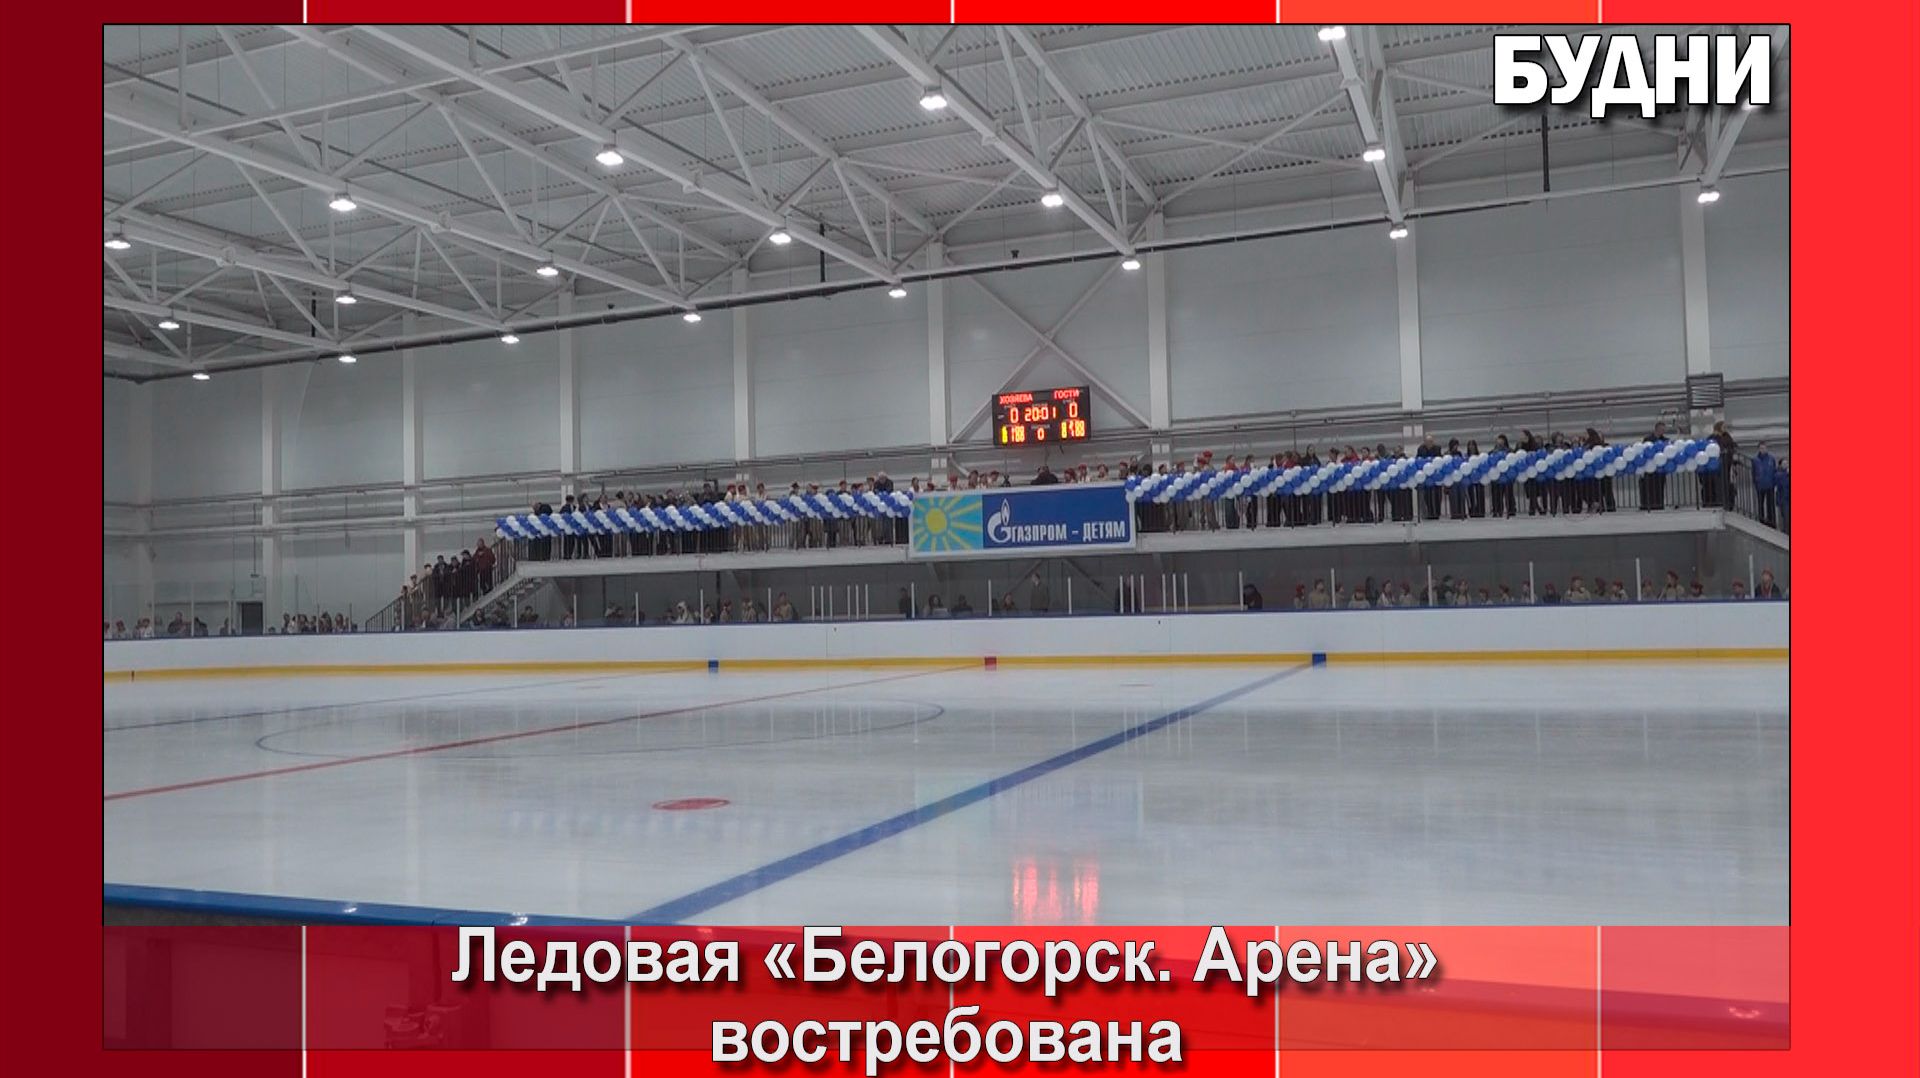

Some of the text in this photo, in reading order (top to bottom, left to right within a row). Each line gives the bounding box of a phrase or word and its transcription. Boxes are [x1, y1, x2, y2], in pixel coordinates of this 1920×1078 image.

[1054, 389, 1080, 400] ГОСТИ
[1010, 406, 1019, 424] 0
[1069, 401, 1078, 418] 0
[1011, 524, 1067, 543] ГАЗПРОМ
[1083, 520, 1125, 541] ДЕТЯМ
